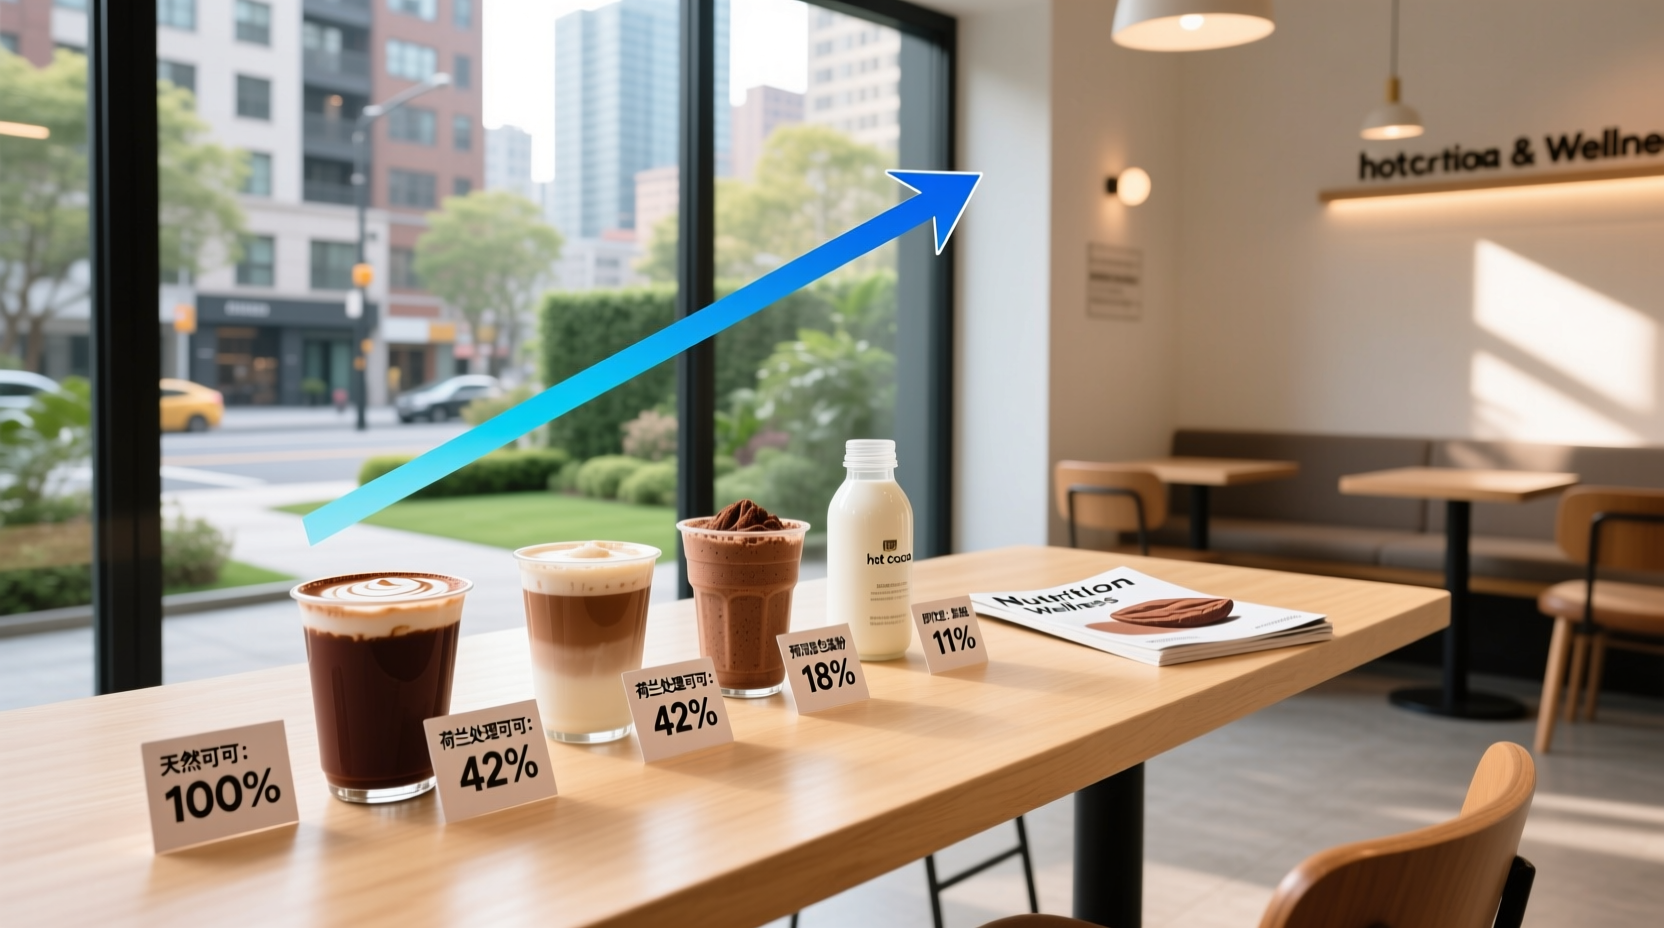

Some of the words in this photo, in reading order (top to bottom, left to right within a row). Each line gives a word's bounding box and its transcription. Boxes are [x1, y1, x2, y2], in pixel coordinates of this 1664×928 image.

[1511, 137, 1535, 167] &
[933, 625, 976, 654] 11%
[801, 657, 856, 693] 18%
[655, 696, 718, 736] 42%
[460, 744, 538, 791] 42%
[164, 767, 281, 823] 100%
